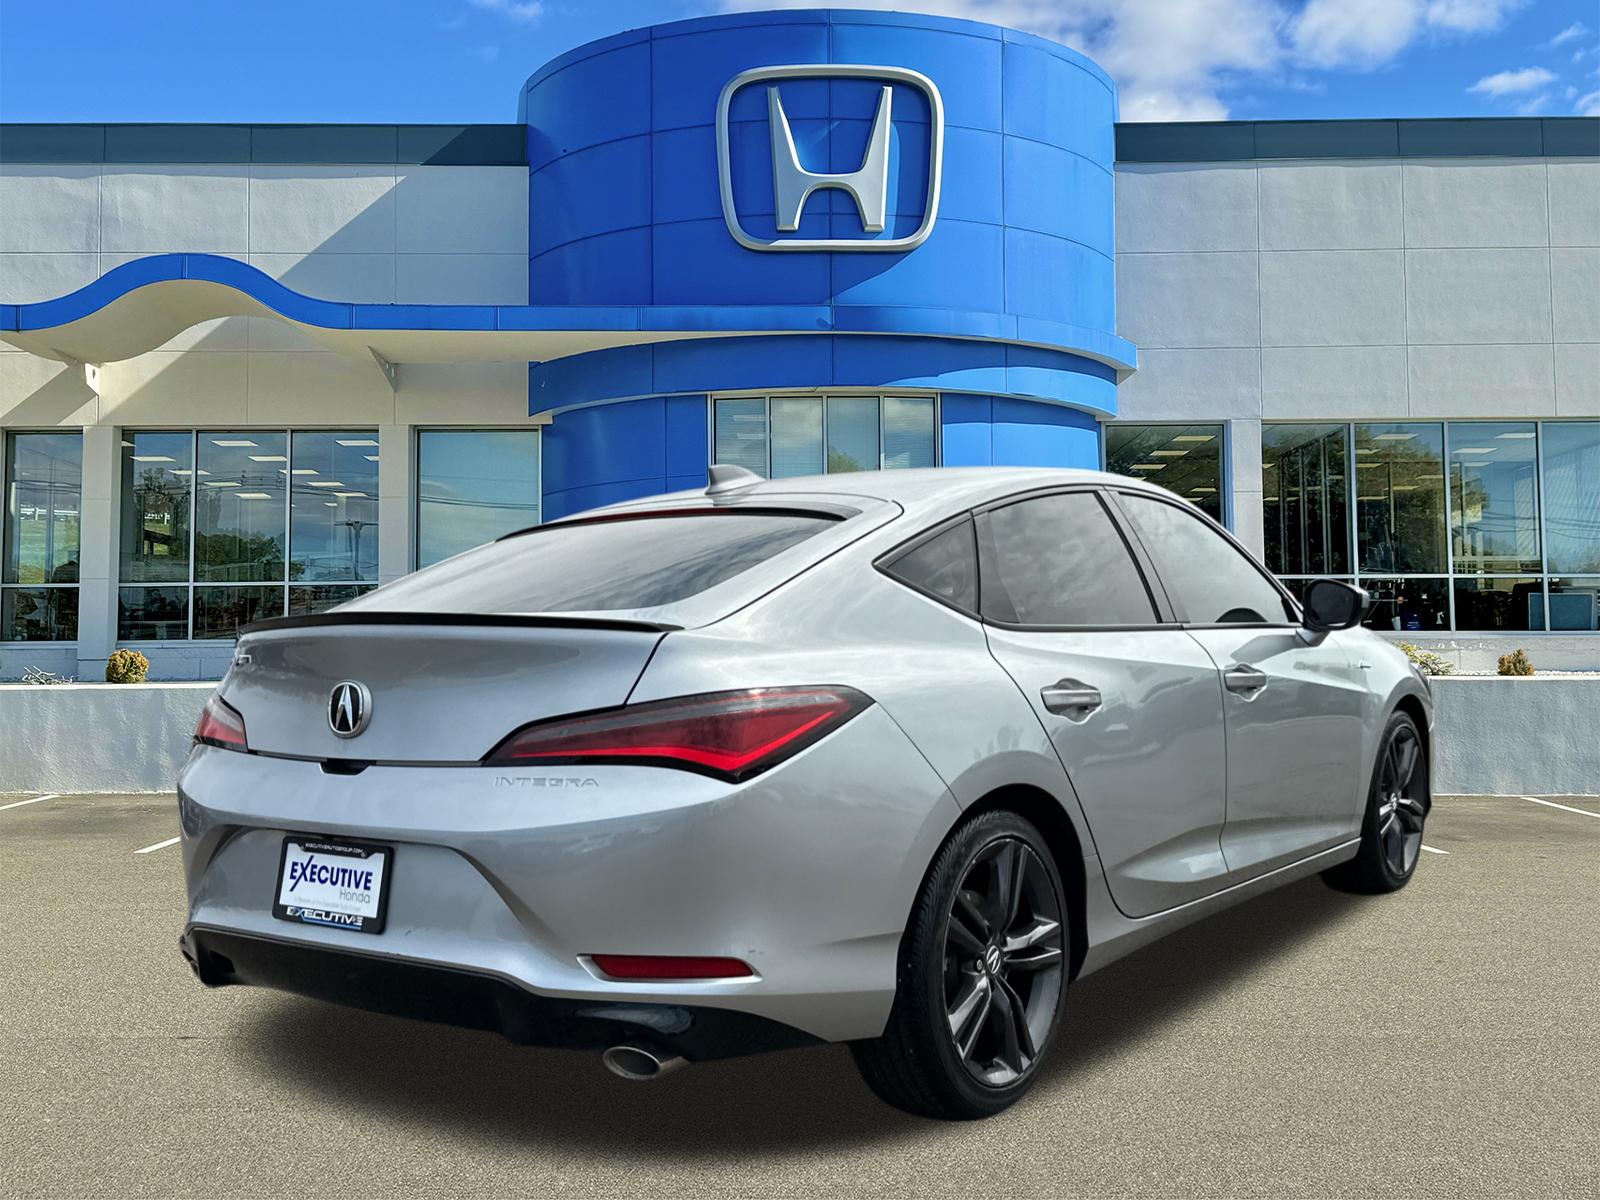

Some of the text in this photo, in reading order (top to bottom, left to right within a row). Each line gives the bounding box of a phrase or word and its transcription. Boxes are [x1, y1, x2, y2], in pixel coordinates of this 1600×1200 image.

[495, 776, 599, 787] INTEGRA
[289, 855, 373, 891] EXECUTIVE
[340, 889, 371, 904] Honda
[286, 906, 363, 926] EXECUTIVE
